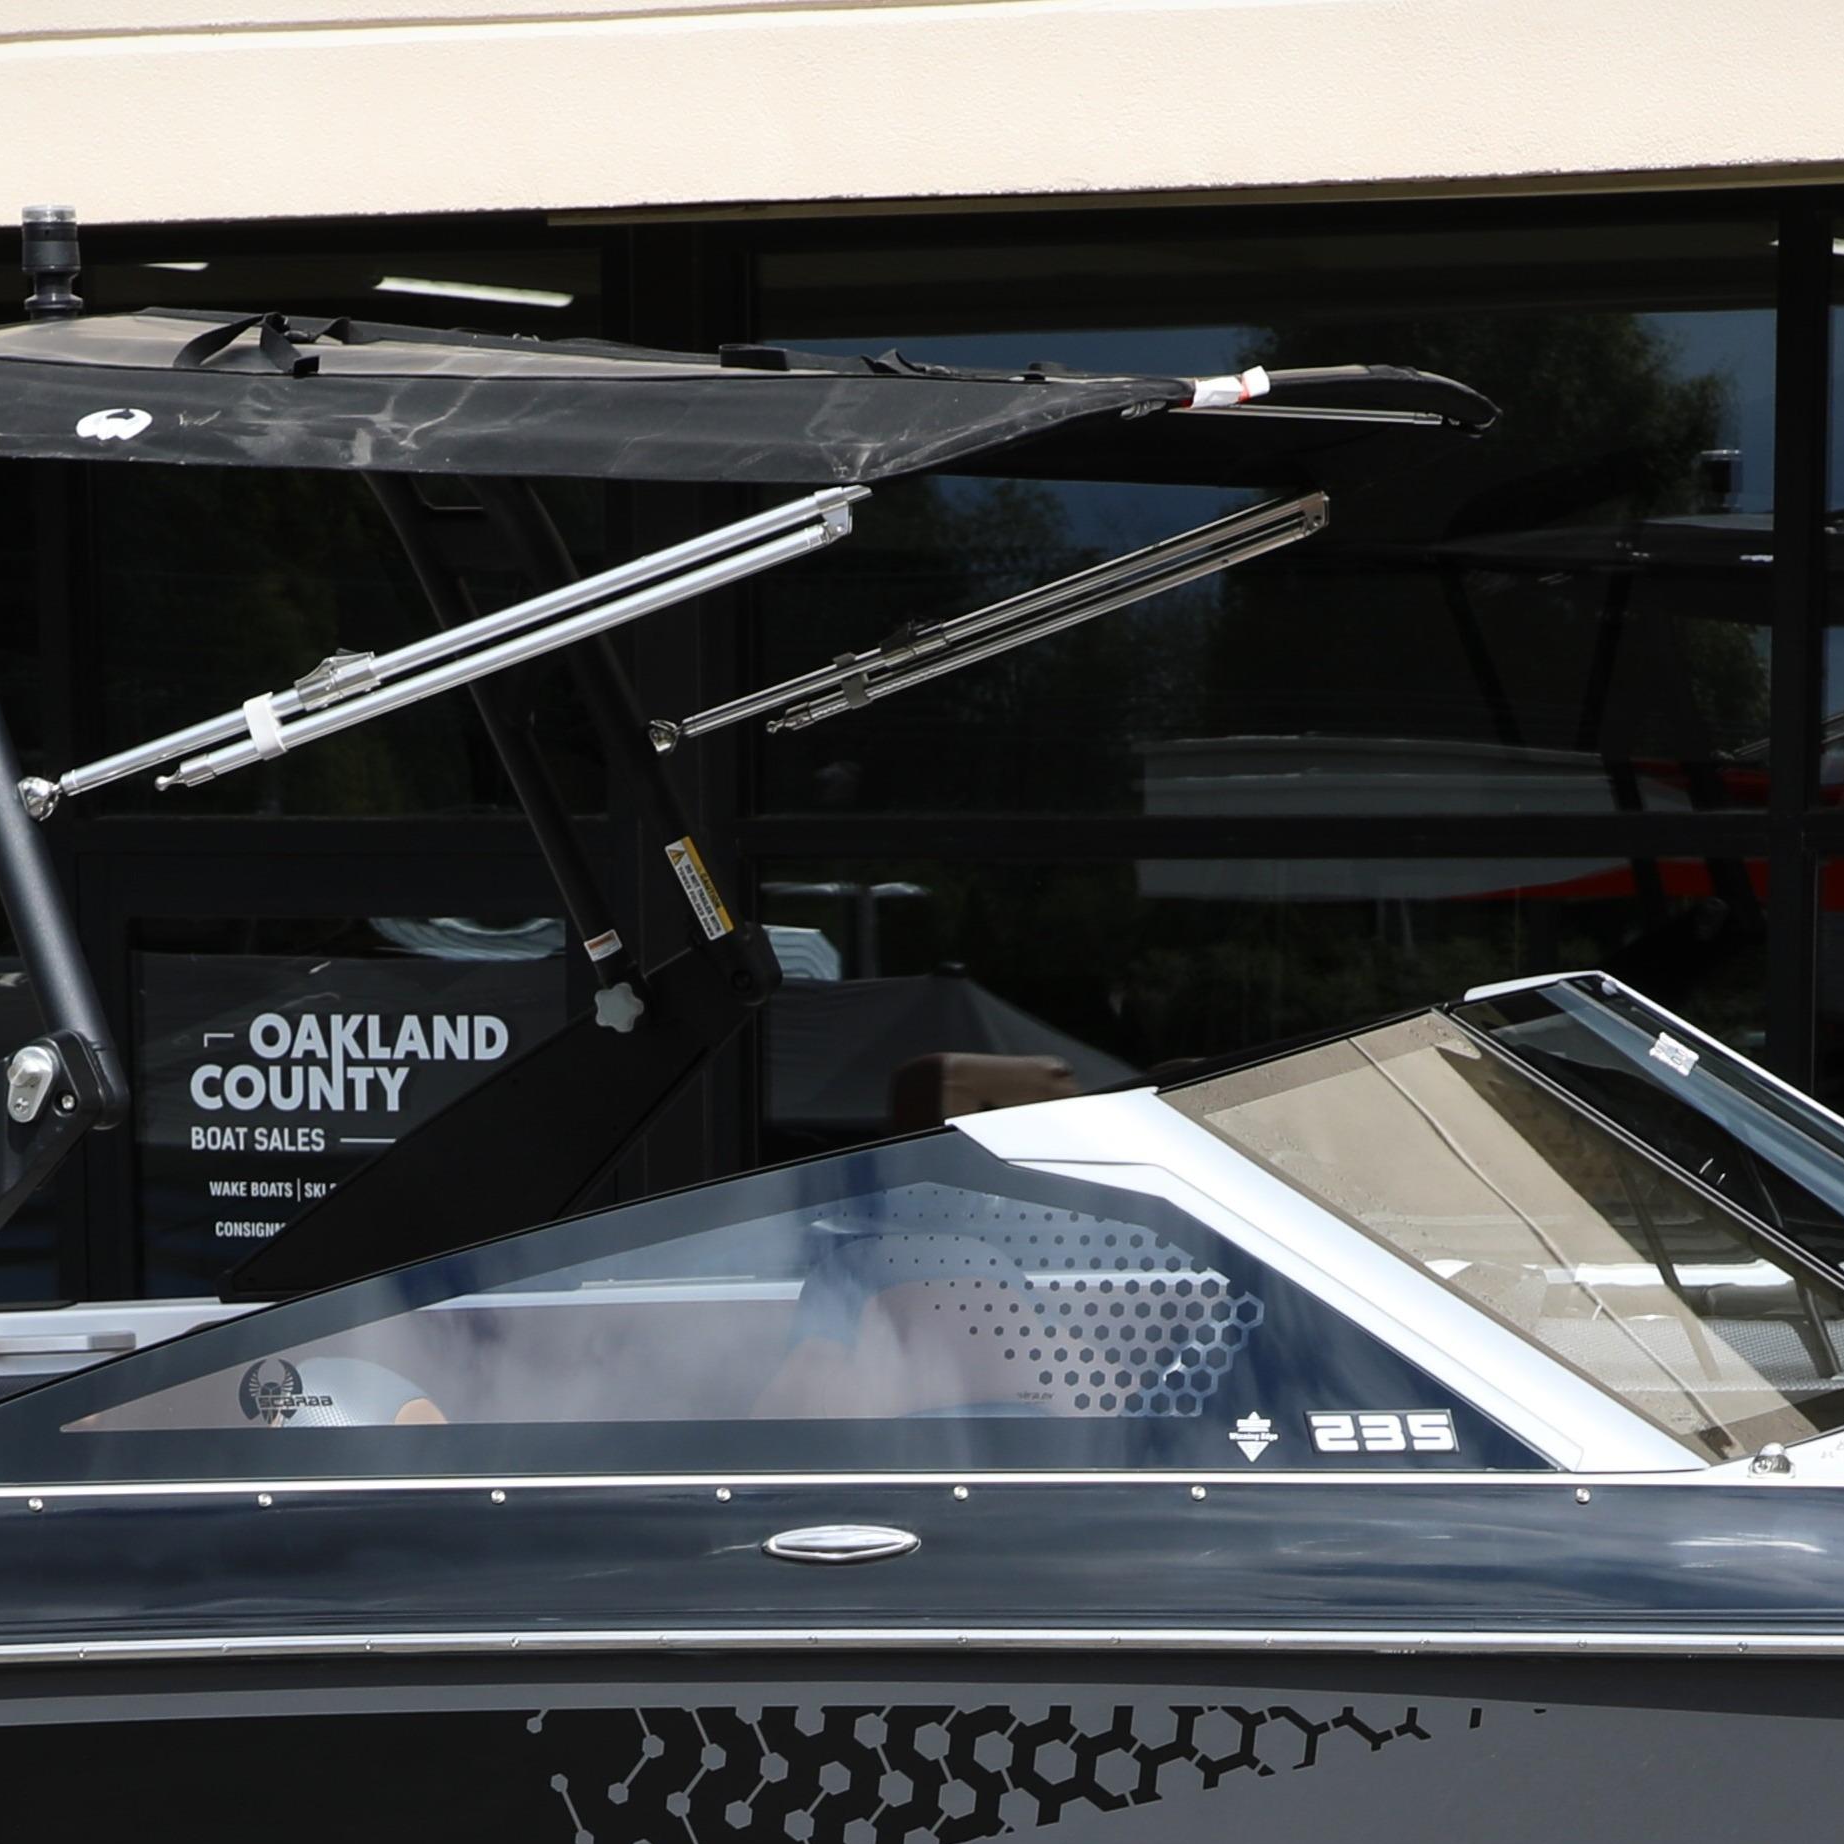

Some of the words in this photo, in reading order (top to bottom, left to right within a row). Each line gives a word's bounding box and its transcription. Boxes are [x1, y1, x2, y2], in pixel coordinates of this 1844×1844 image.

[249, 1013, 508, 1061] OAKLAND
[190, 1064, 409, 1111] COUNTY
[191, 1126, 247, 1151] BOAT
[254, 1128, 325, 1152] SALES
[209, 1181, 247, 1197] WAKE
[250, 1182, 293, 1198] BOATS
[304, 1182, 326, 1198] SKI
[1228, 1432, 1260, 1441] Winning
[1260, 1432, 1279, 1442] Edge
[1310, 1413, 1455, 1452] 235
